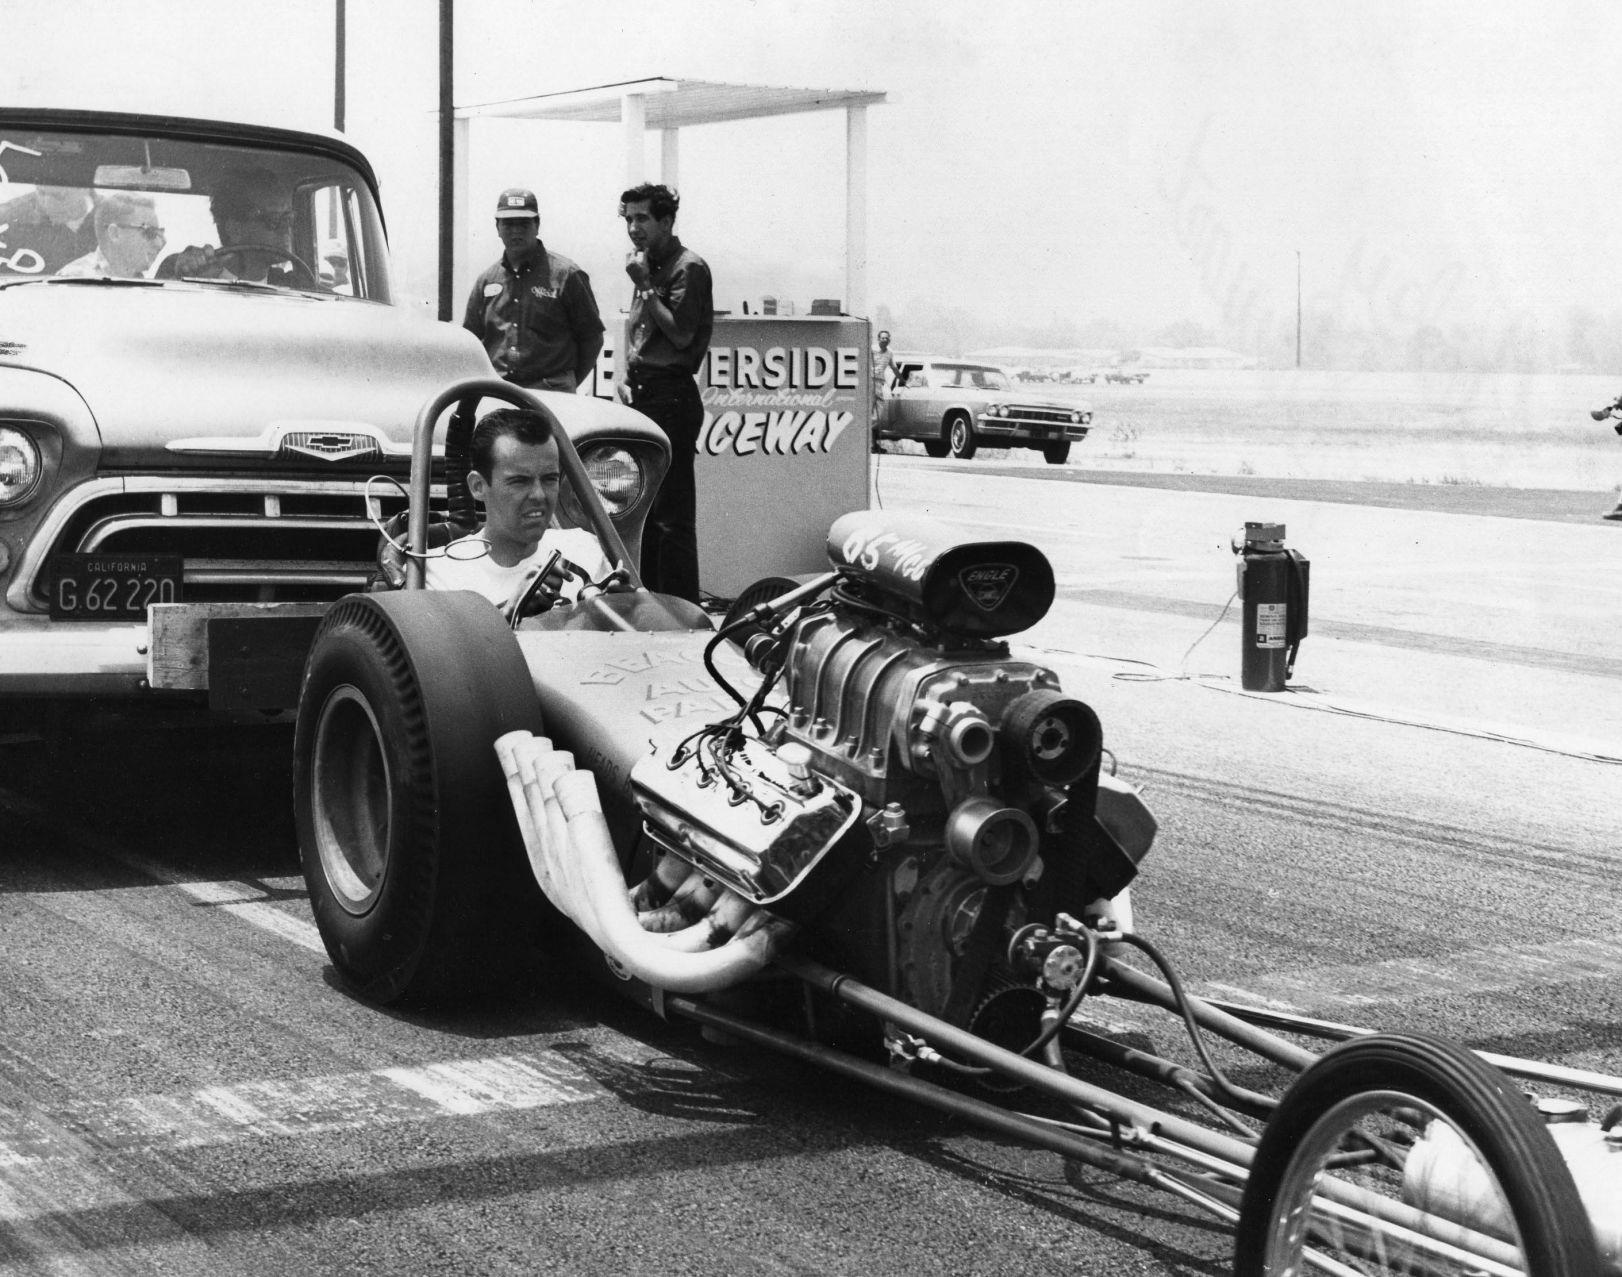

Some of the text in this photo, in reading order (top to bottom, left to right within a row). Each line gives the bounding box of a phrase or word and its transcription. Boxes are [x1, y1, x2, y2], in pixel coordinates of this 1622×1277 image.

[693, 346, 860, 390] ERSIDE
[695, 410, 854, 456] CEWAY
[87, 562, 148, 573] CALIFORNIA
